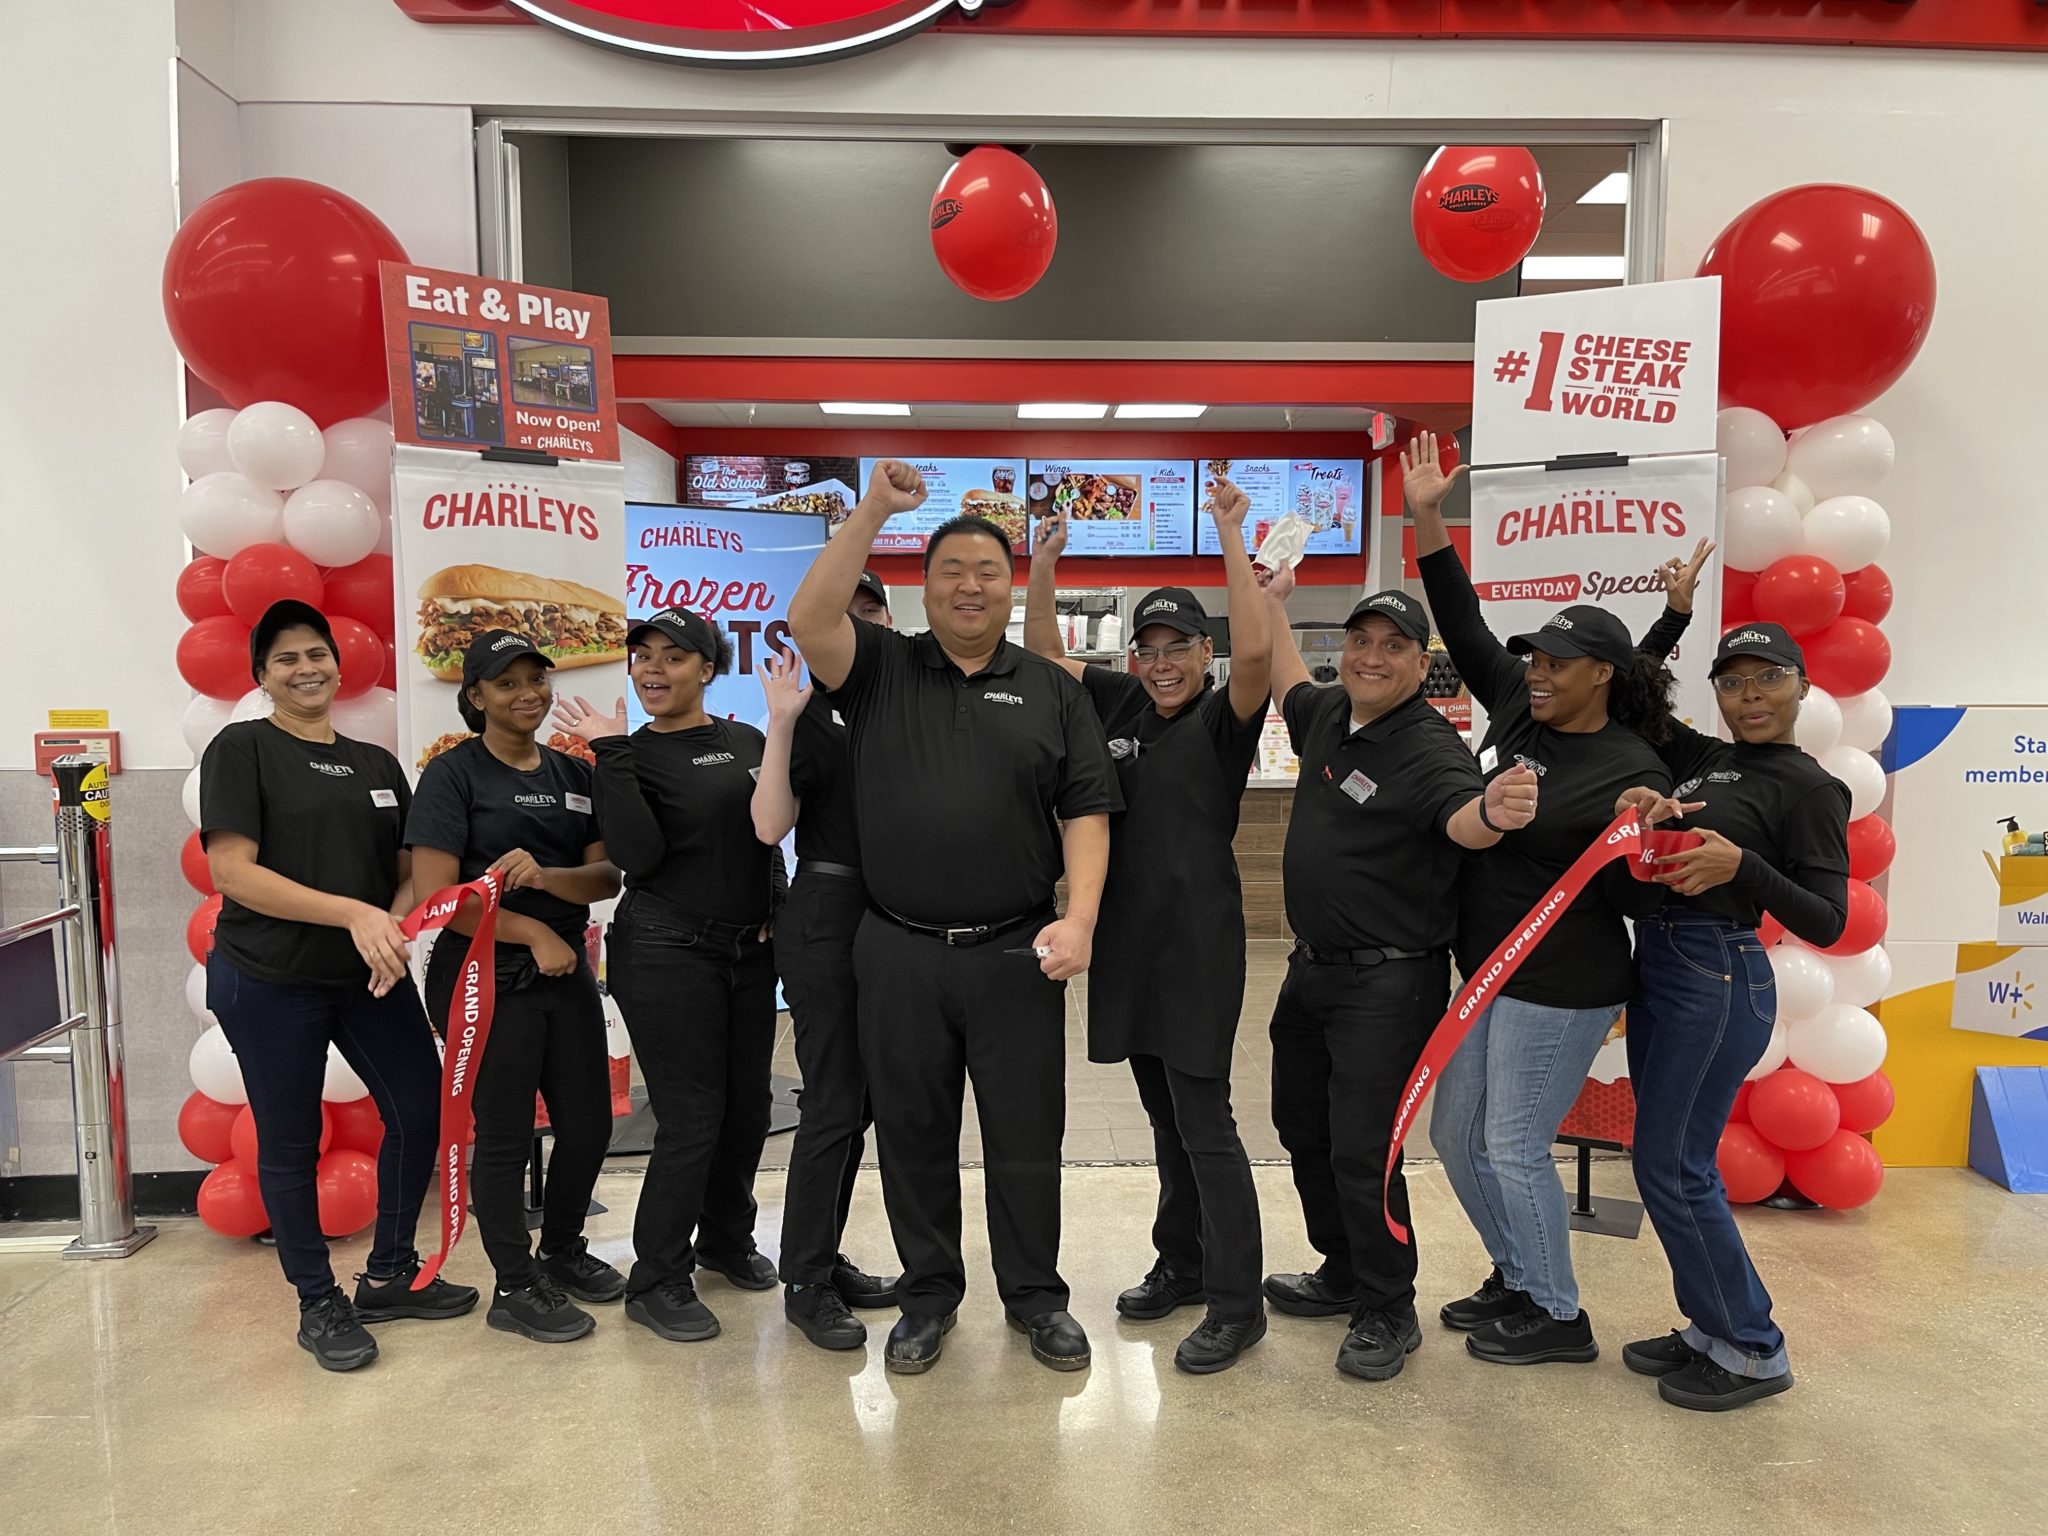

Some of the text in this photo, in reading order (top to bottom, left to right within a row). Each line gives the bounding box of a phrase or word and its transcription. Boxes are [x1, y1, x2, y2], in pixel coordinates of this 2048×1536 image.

[1438, 189, 1500, 207] CHARLEYS
[932, 201, 963, 222] ARLEYS
[406, 275, 591, 340] Eat & Play
[1574, 334, 1691, 363] CHEESE
[1493, 331, 1565, 412] #1
[1567, 356, 1685, 389] STEAK
[1602, 385, 1640, 397] IN THE
[1562, 392, 1676, 424] WORLD
[516, 411, 601, 433] Now Open!
[520, 435, 593, 453] at CHARLEYS
[721, 467, 737, 475] The
[916, 462, 938, 472] teaks
[1045, 464, 1071, 474] Wings
[1159, 468, 1176, 477] Kids
[1245, 463, 1270, 473] Snacks
[1311, 467, 1343, 480] Treats
[692, 474, 767, 490] Old School
[422, 492, 599, 541] CHARLEYS
[1496, 499, 1687, 546] CHARLEYS
[640, 527, 743, 553] CHARLEYS
[626, 564, 775, 620] Frozen
[1491, 568, 1700, 602] EVERYDAY Speci
[984, 691, 1023, 704] CHARLEYS
[310, 761, 354, 774] CHARLEYS
[693, 752, 735, 765] CHARLEYS
[514, 794, 557, 804] CHARLEYS
[1607, 822, 1641, 844] GRA
[422, 899, 458, 920] RAN
[1459, 890, 1566, 1020] GRAND OPENING
[452, 960, 479, 1097] GRAND OPENING
[1392, 1064, 1431, 1142] OPENING
[448, 1143, 460, 1254] GRAND OPEN
